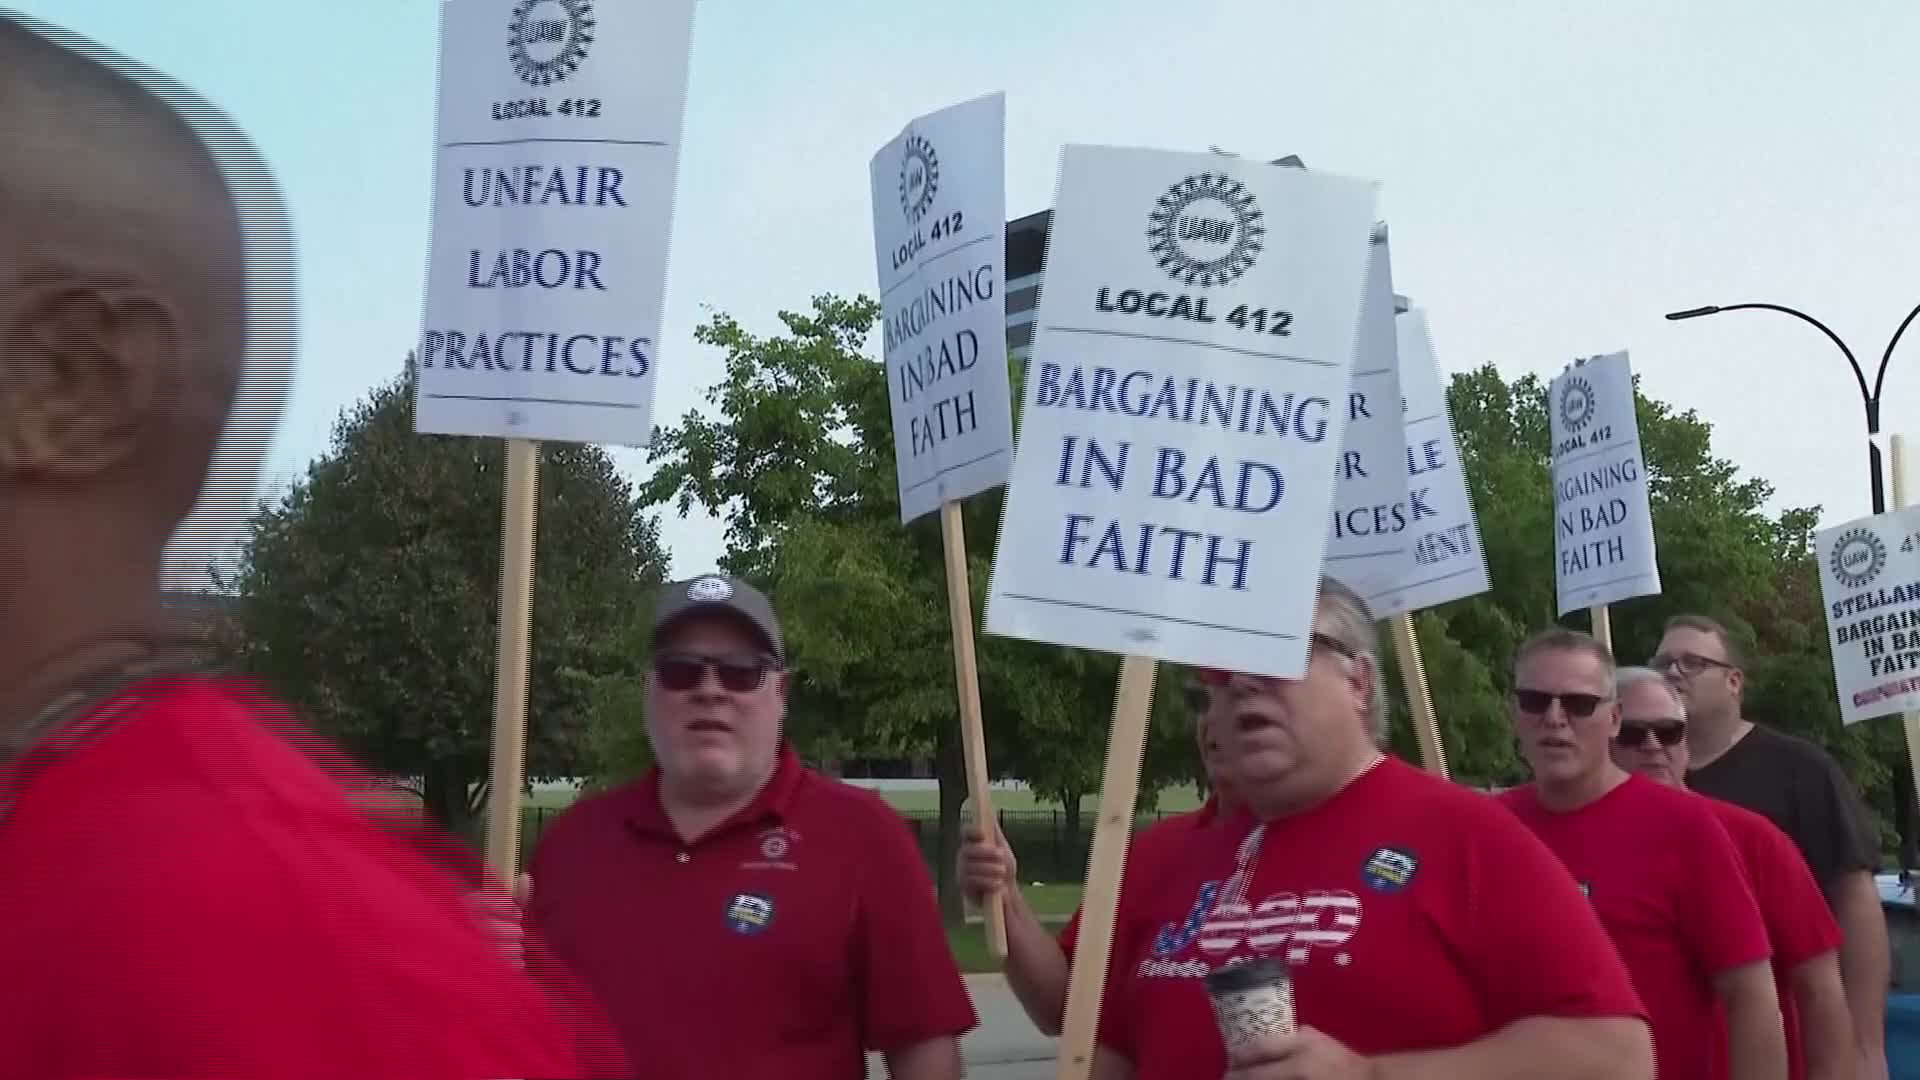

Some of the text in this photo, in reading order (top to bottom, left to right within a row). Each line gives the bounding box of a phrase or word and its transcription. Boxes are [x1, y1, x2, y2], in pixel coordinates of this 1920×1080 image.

[525, 19, 567, 44] UAW
[493, 98, 602, 120] LOCAL 412
[464, 165, 628, 207] UNFAIR
[931, 211, 963, 240] 412
[1177, 216, 1236, 245] UAW
[468, 249, 607, 290] LABOR
[1096, 287, 1295, 337] LOCAL 412
[423, 330, 651, 378] PRACTICES
[901, 354, 924, 402] IN
[1036, 362, 1331, 444] BARGAINING
[911, 390, 977, 457] FATH
[1590, 425, 1612, 444] 412
[1055, 436, 1286, 514] IN BAD
[1336, 450, 1368, 480] R
[1407, 438, 1446, 476] LE
[1334, 501, 1407, 539] ICES
[1409, 487, 1439, 520] K
[1580, 498, 1627, 533] BAD
[1059, 513, 1257, 592] FAITH
[1562, 536, 1625, 576] FAITH
[1843, 549, 1868, 568] UAW
[1833, 583, 1920, 619] STELLAN
[1863, 635, 1885, 658] IN
[1152, 880, 1363, 966] Jeep
